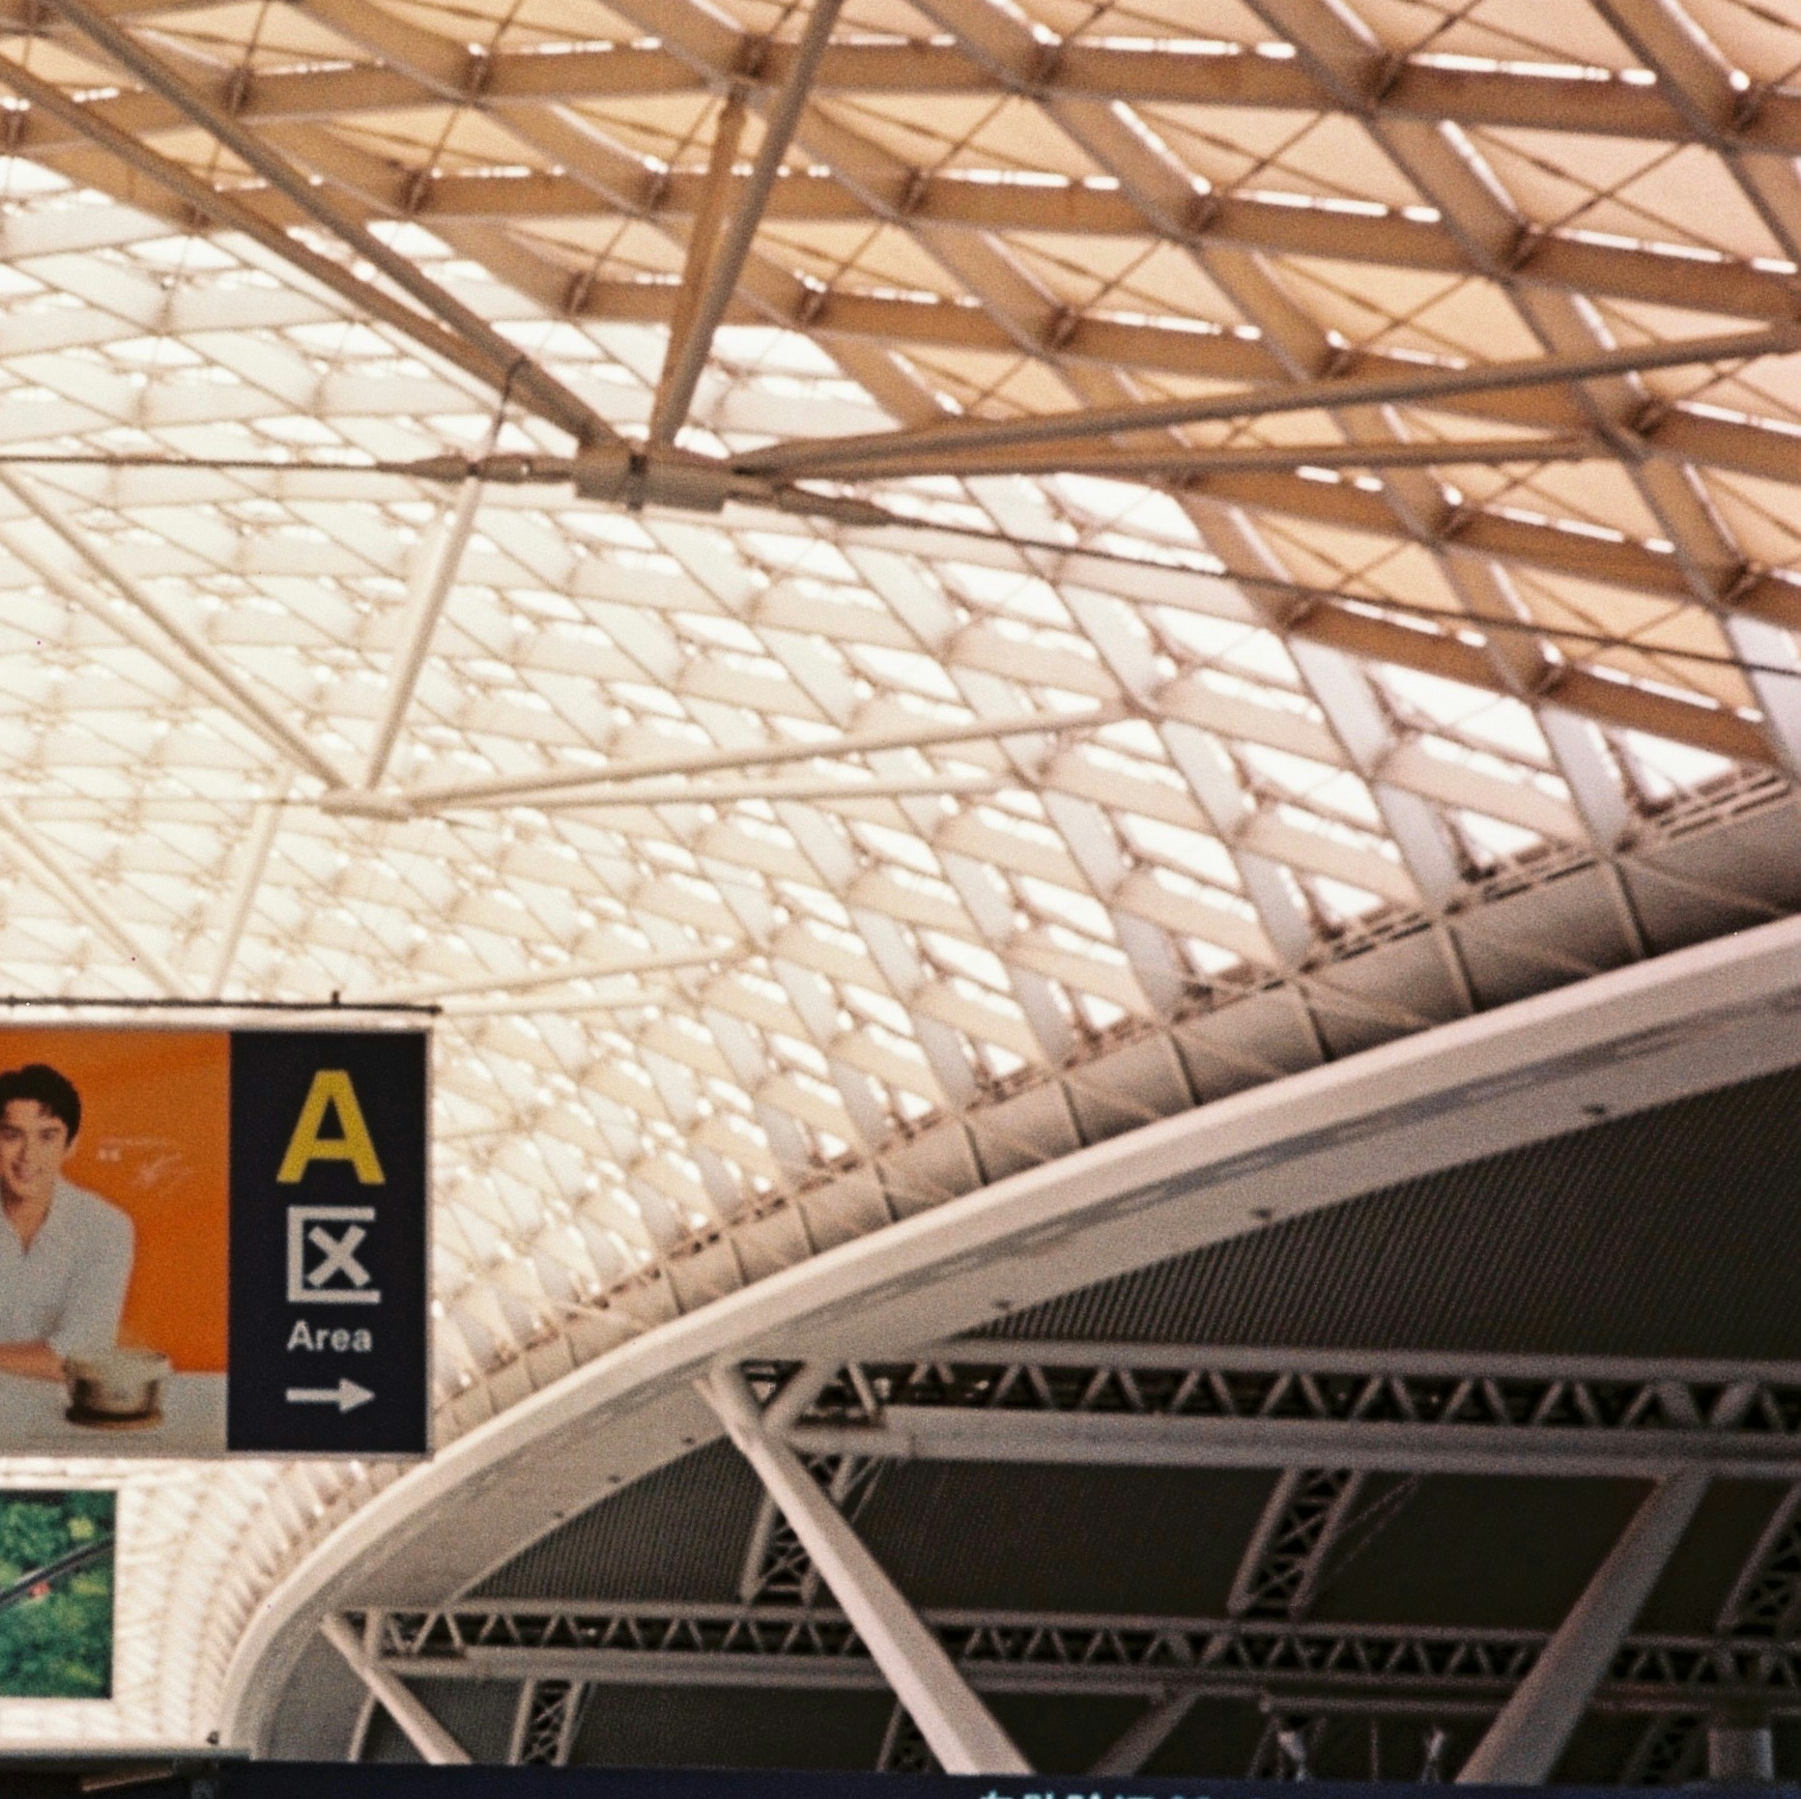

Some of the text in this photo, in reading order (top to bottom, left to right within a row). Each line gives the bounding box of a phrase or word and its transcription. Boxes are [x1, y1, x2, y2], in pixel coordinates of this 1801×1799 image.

[276, 1069, 387, 1185] A
[286, 1206, 382, 1304] 区
[286, 1320, 374, 1352] Area
